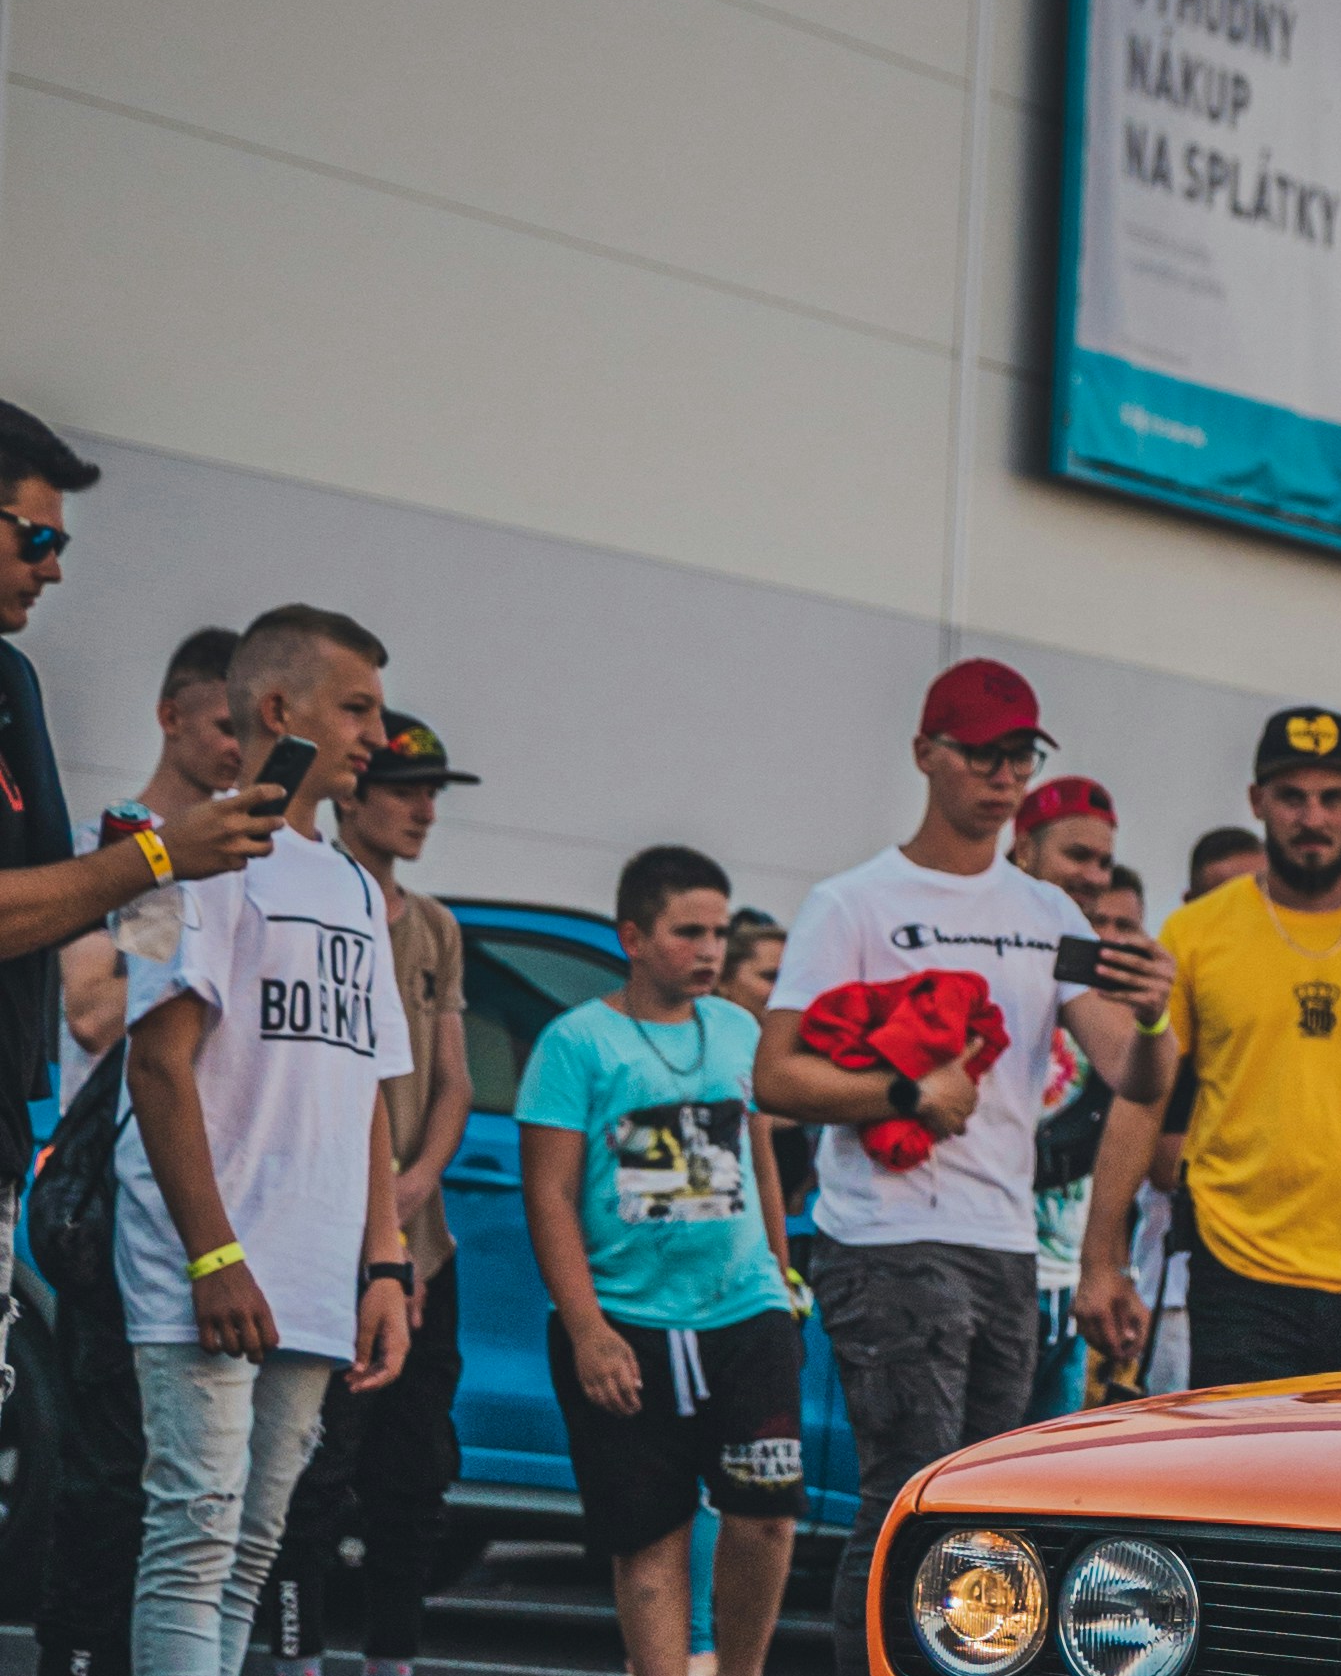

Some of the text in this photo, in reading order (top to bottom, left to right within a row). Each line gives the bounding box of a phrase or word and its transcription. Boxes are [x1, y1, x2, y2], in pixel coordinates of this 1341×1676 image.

[1124, 26, 1252, 127] NÁKUP
[1123, 121, 1174, 194] NA
[1183, 142, 1341, 250] SPLÁTKY
